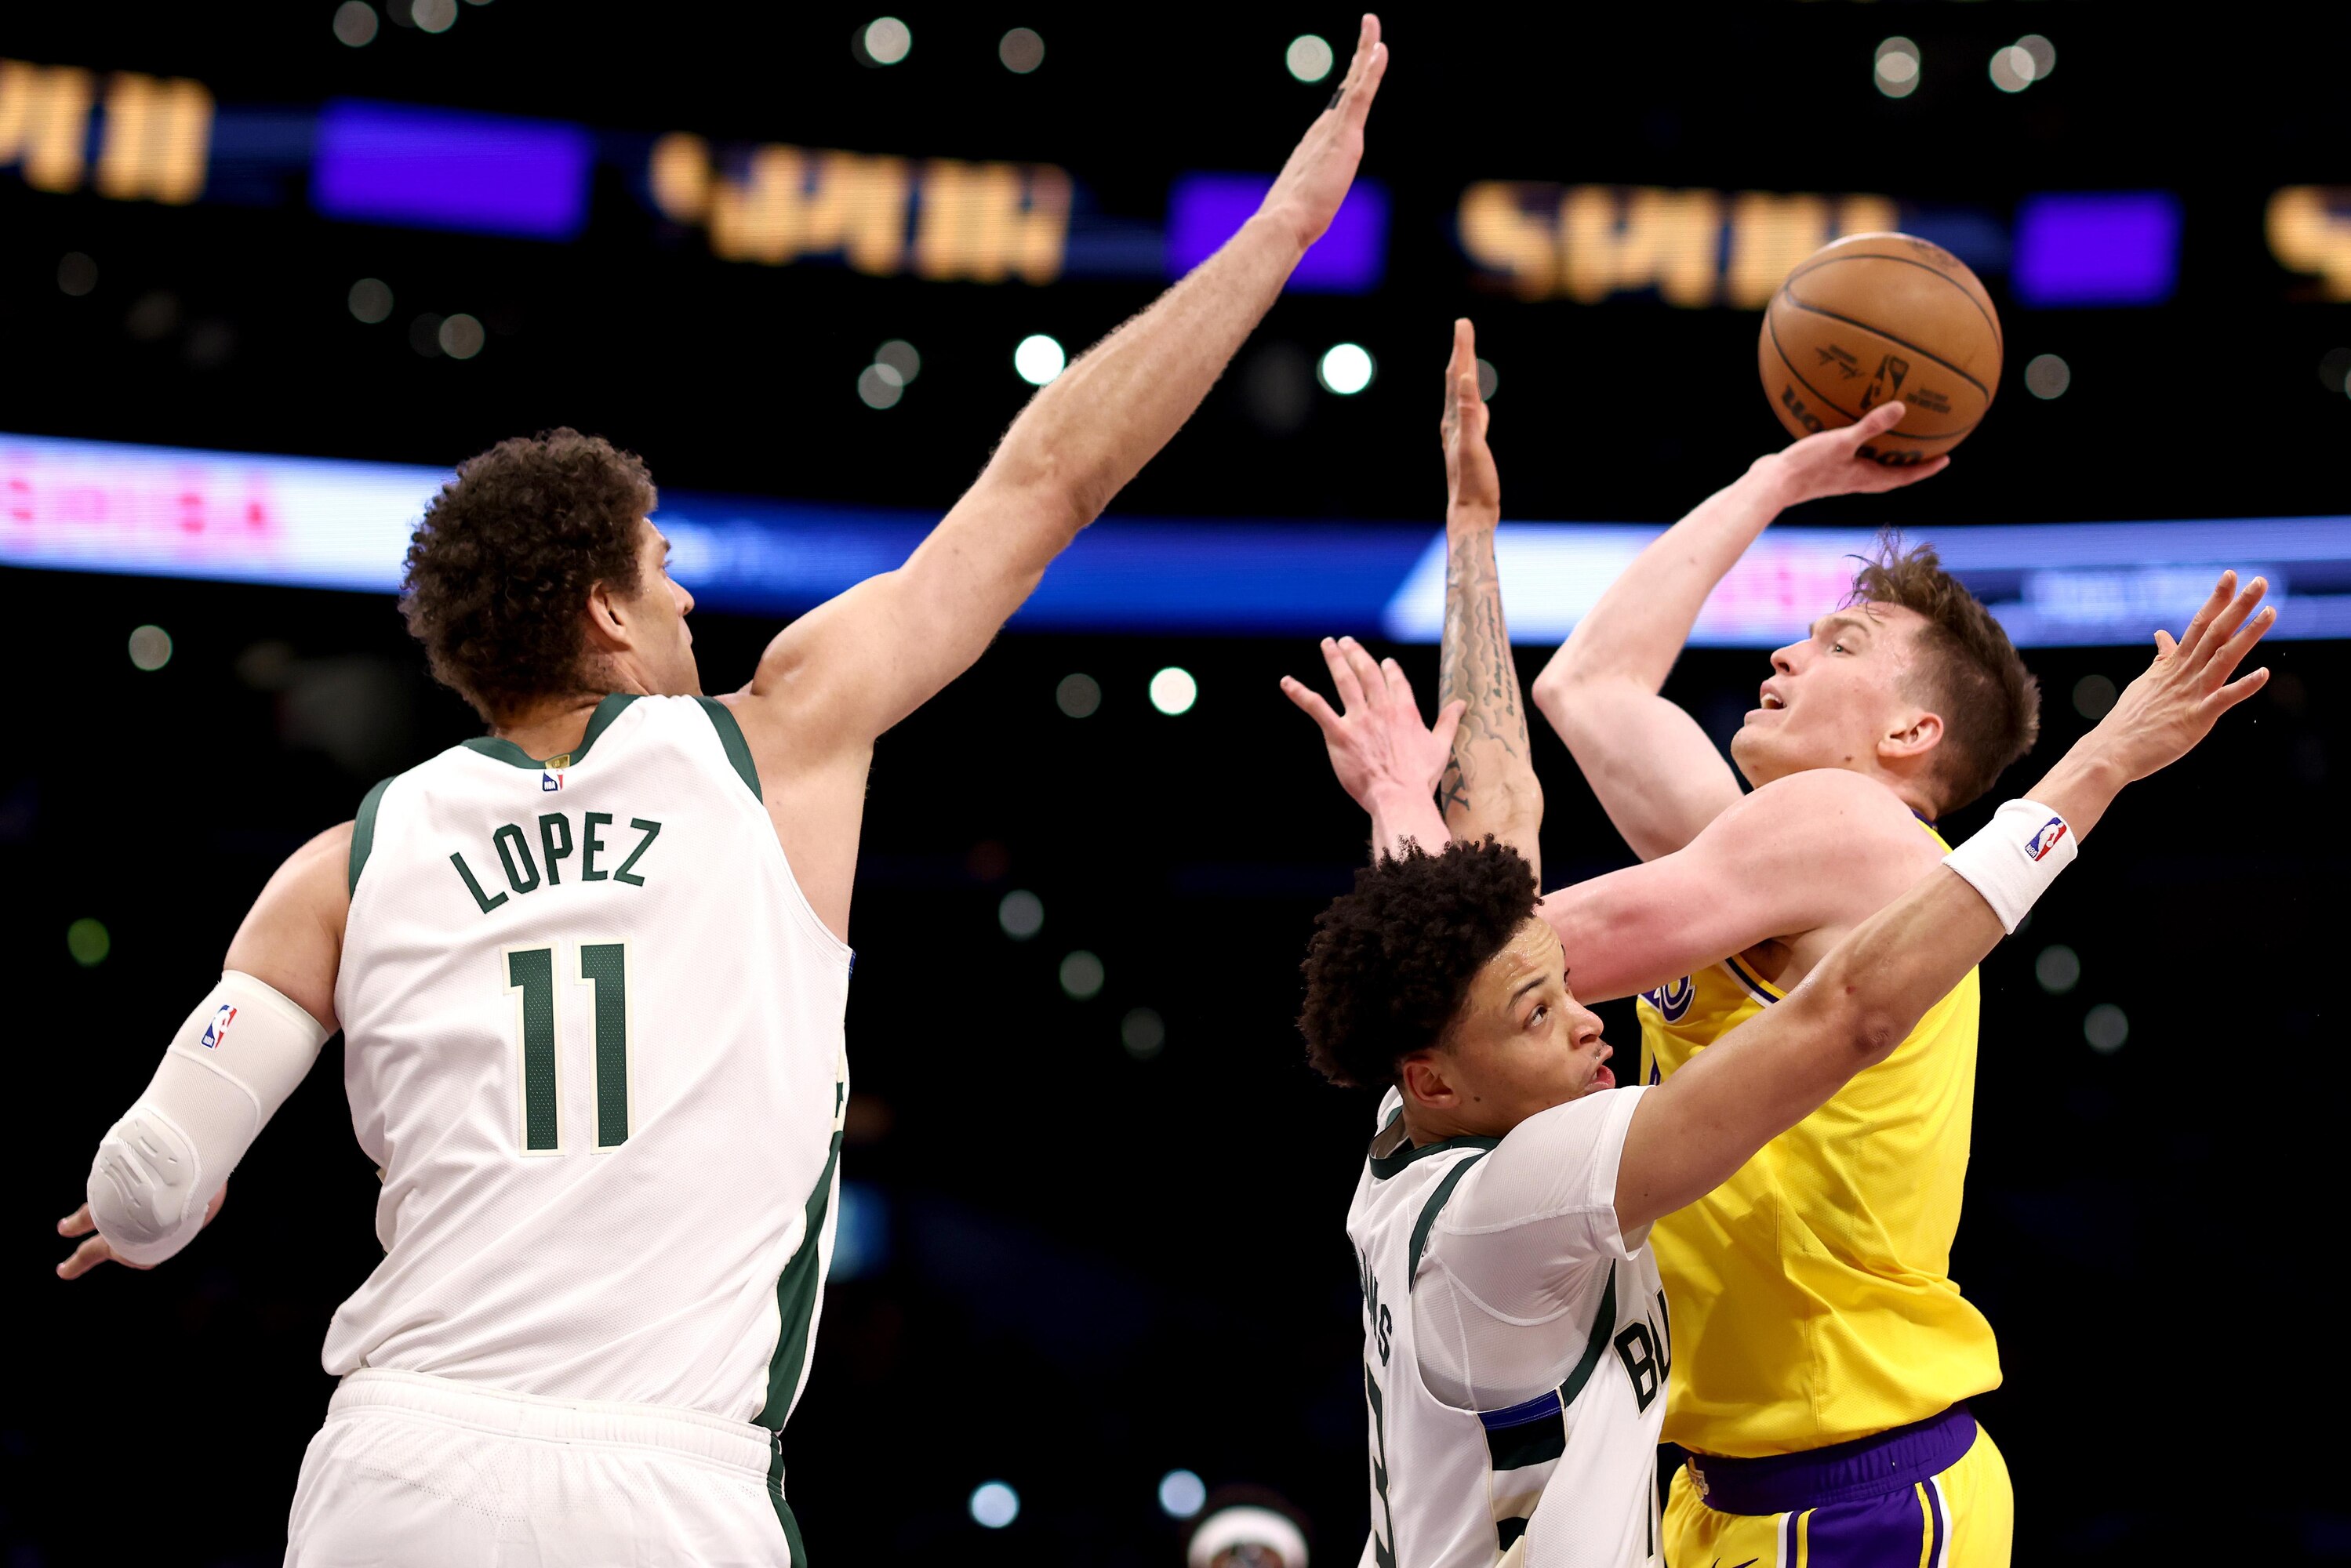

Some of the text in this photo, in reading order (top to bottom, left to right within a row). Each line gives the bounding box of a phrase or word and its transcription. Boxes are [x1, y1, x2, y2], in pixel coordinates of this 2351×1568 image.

[449, 811, 662, 915] LOPEZ
[2025, 844, 2038, 858] NBA
[502, 939, 632, 1156] 11
